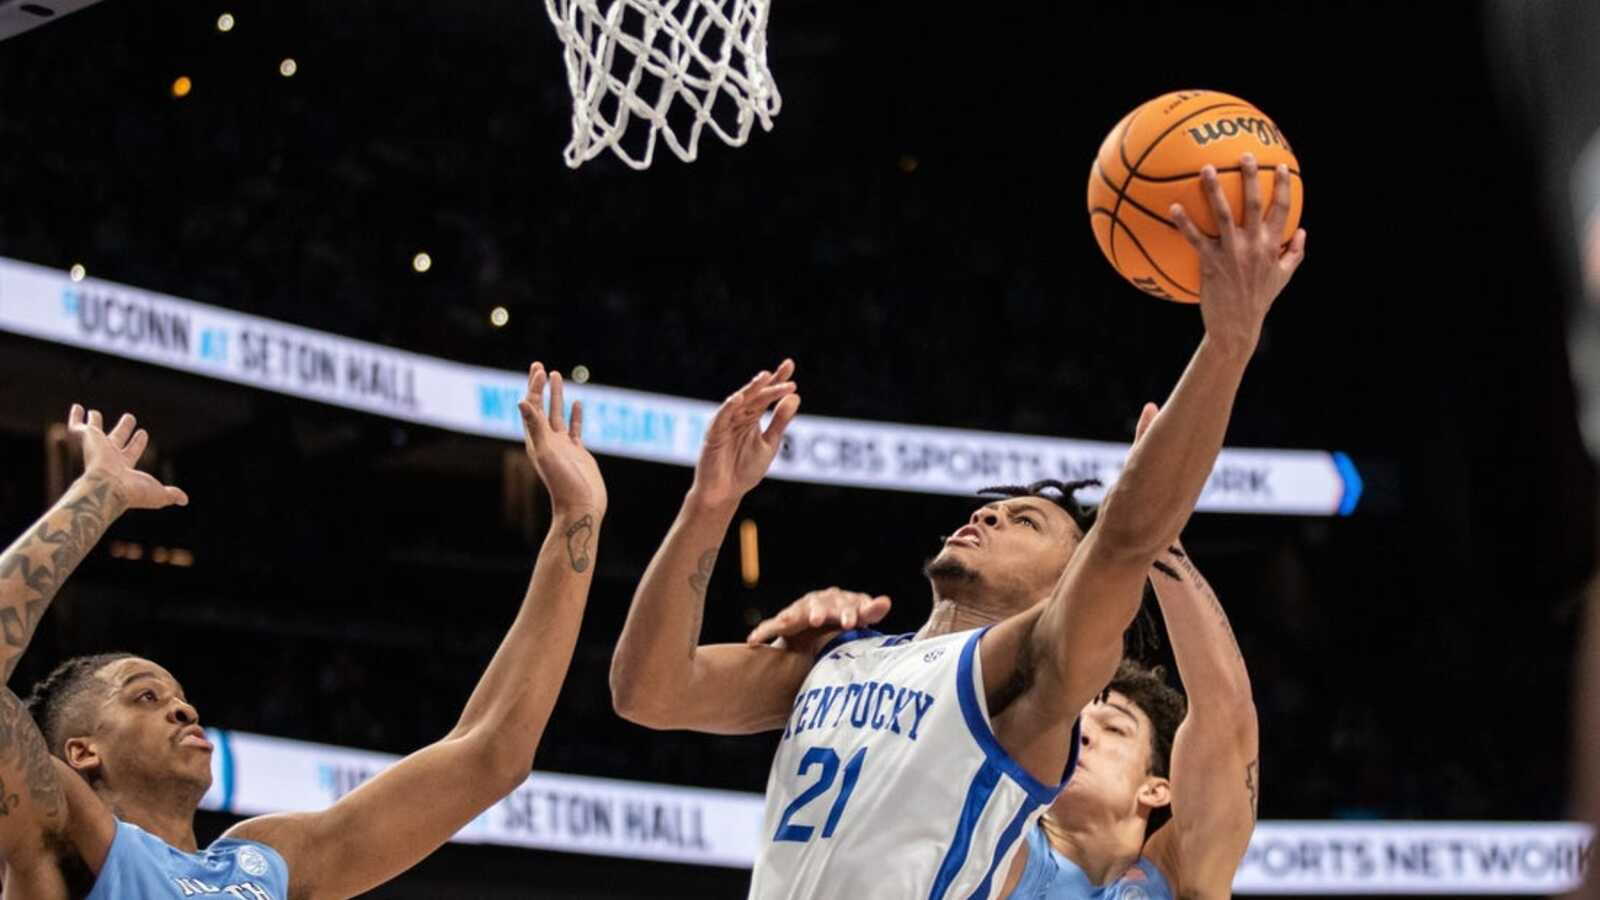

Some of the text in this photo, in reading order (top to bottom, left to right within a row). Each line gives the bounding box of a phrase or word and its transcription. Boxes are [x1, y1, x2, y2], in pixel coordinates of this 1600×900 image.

[1188, 117, 1293, 151] ilson
[79, 292, 191, 354] UCONN
[240, 330, 336, 386] SETON
[347, 354, 419, 408] HALL
[478, 383, 673, 443] WEESDAY
[808, 432, 1274, 495] CBS SPORTS NERK
[503, 788, 613, 838] SETON
[623, 800, 711, 851] HALL
[772, 746, 868, 842] 21
[1243, 839, 1593, 878] ORTS NETWORK
